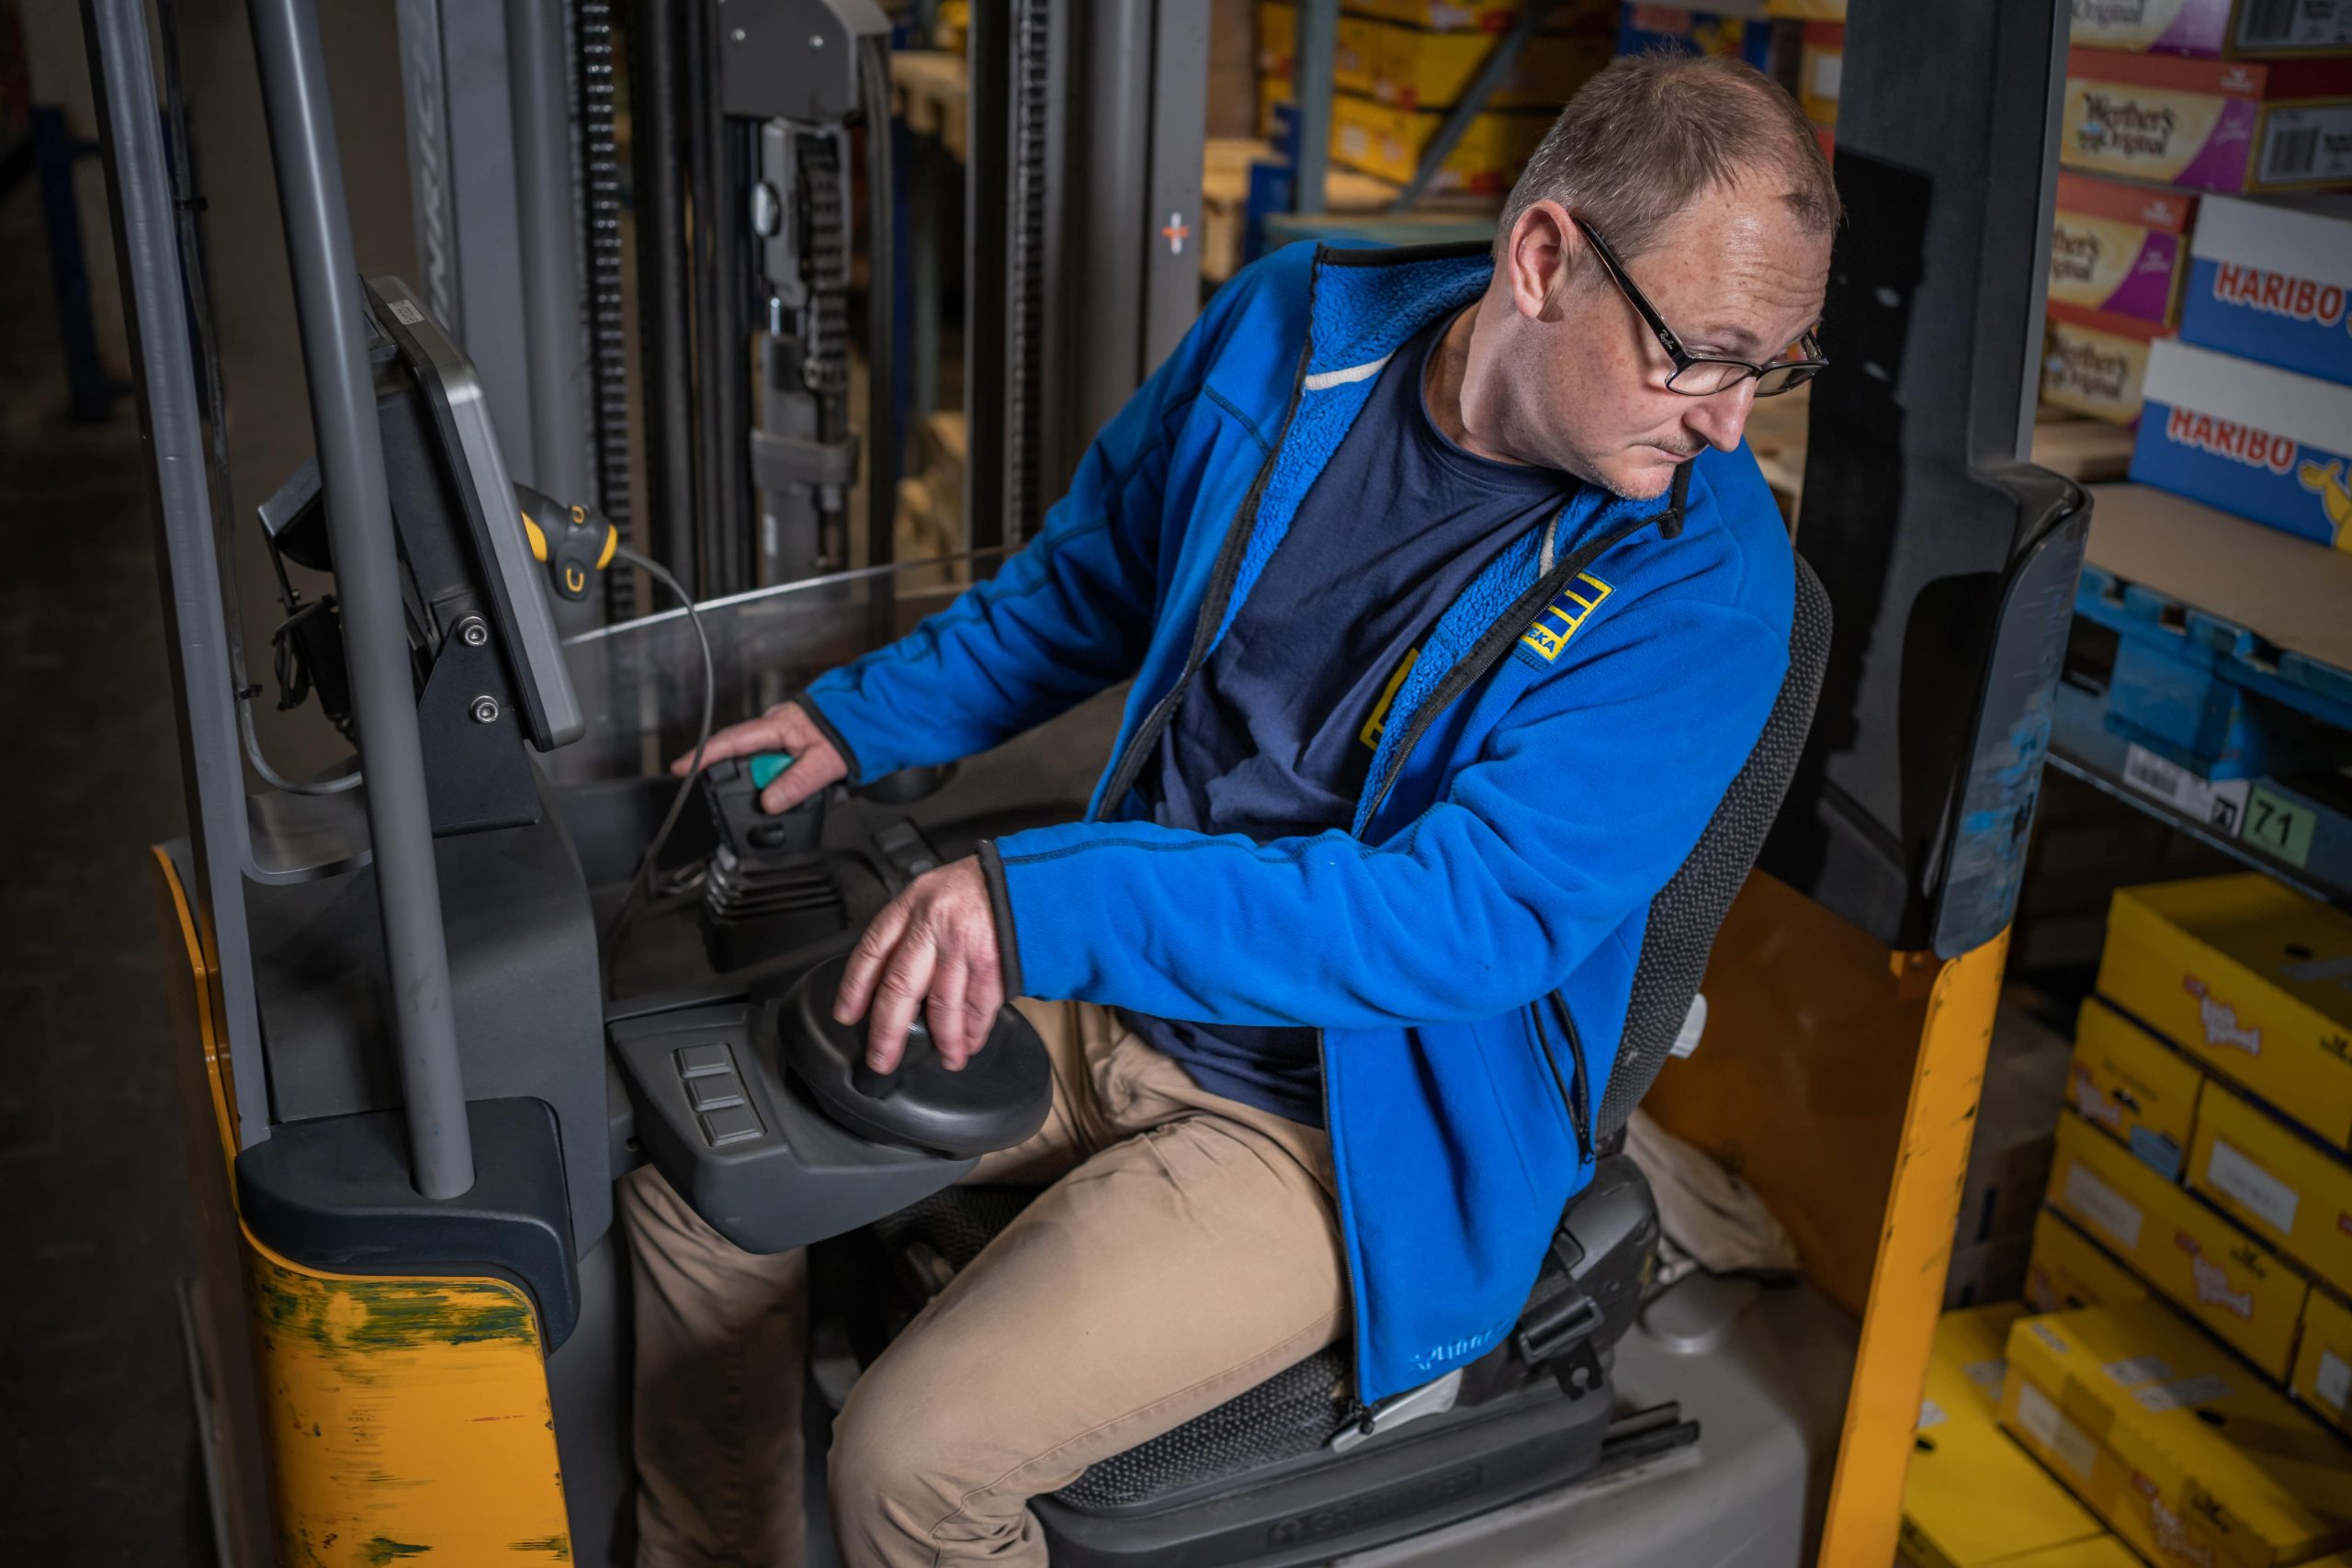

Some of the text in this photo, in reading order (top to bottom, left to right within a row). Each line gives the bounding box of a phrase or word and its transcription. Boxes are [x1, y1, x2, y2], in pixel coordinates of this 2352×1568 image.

[2110, 130, 2167, 160] riginal
[2214, 260, 2345, 325] HARIBO
[2167, 405, 2298, 471] HARIBO
[1526, 626, 1557, 655] EKA
[2254, 798, 2292, 848] 71
